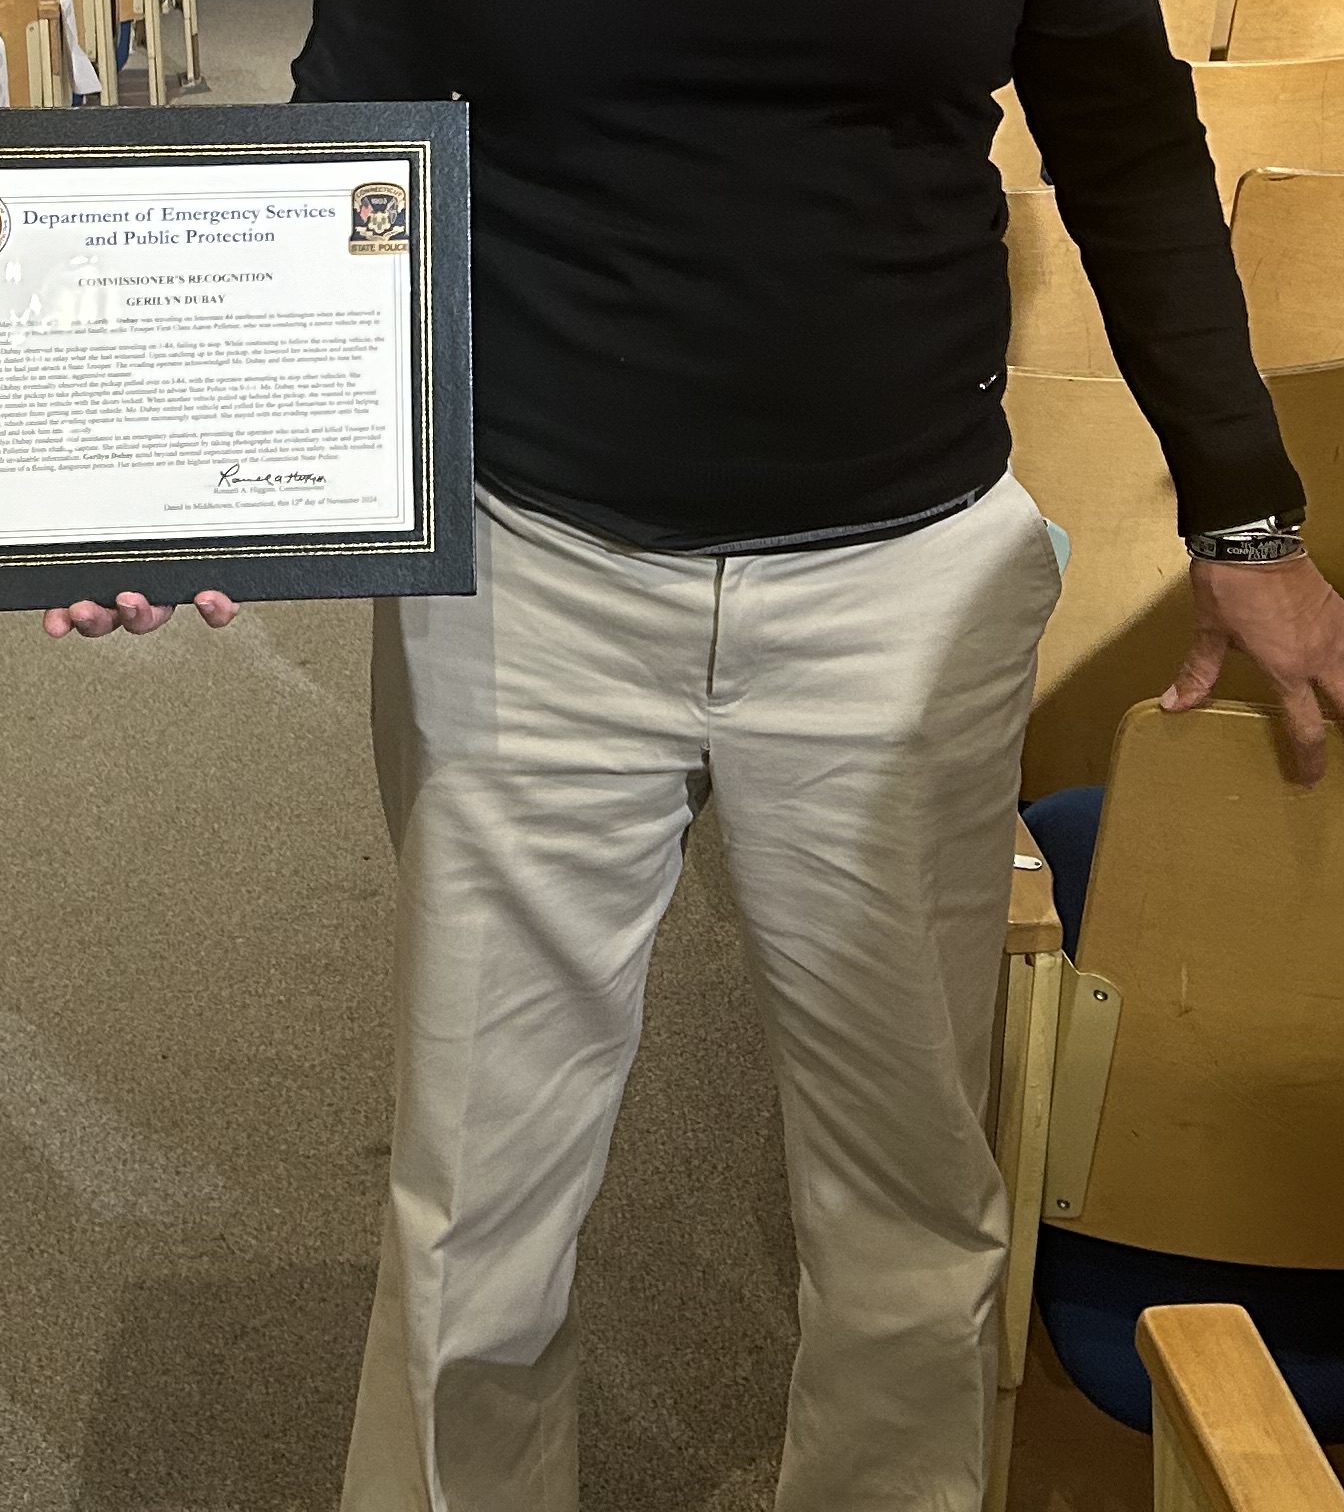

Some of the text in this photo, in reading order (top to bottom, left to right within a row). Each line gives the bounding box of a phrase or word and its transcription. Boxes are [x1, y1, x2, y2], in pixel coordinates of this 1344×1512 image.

[22, 204, 336, 229] Department of Emergency Services
[85, 228, 275, 246] and Public Protection
[188, 272, 274, 284] RECOGNITION
[126, 294, 226, 306] GERILYN DUBAY
